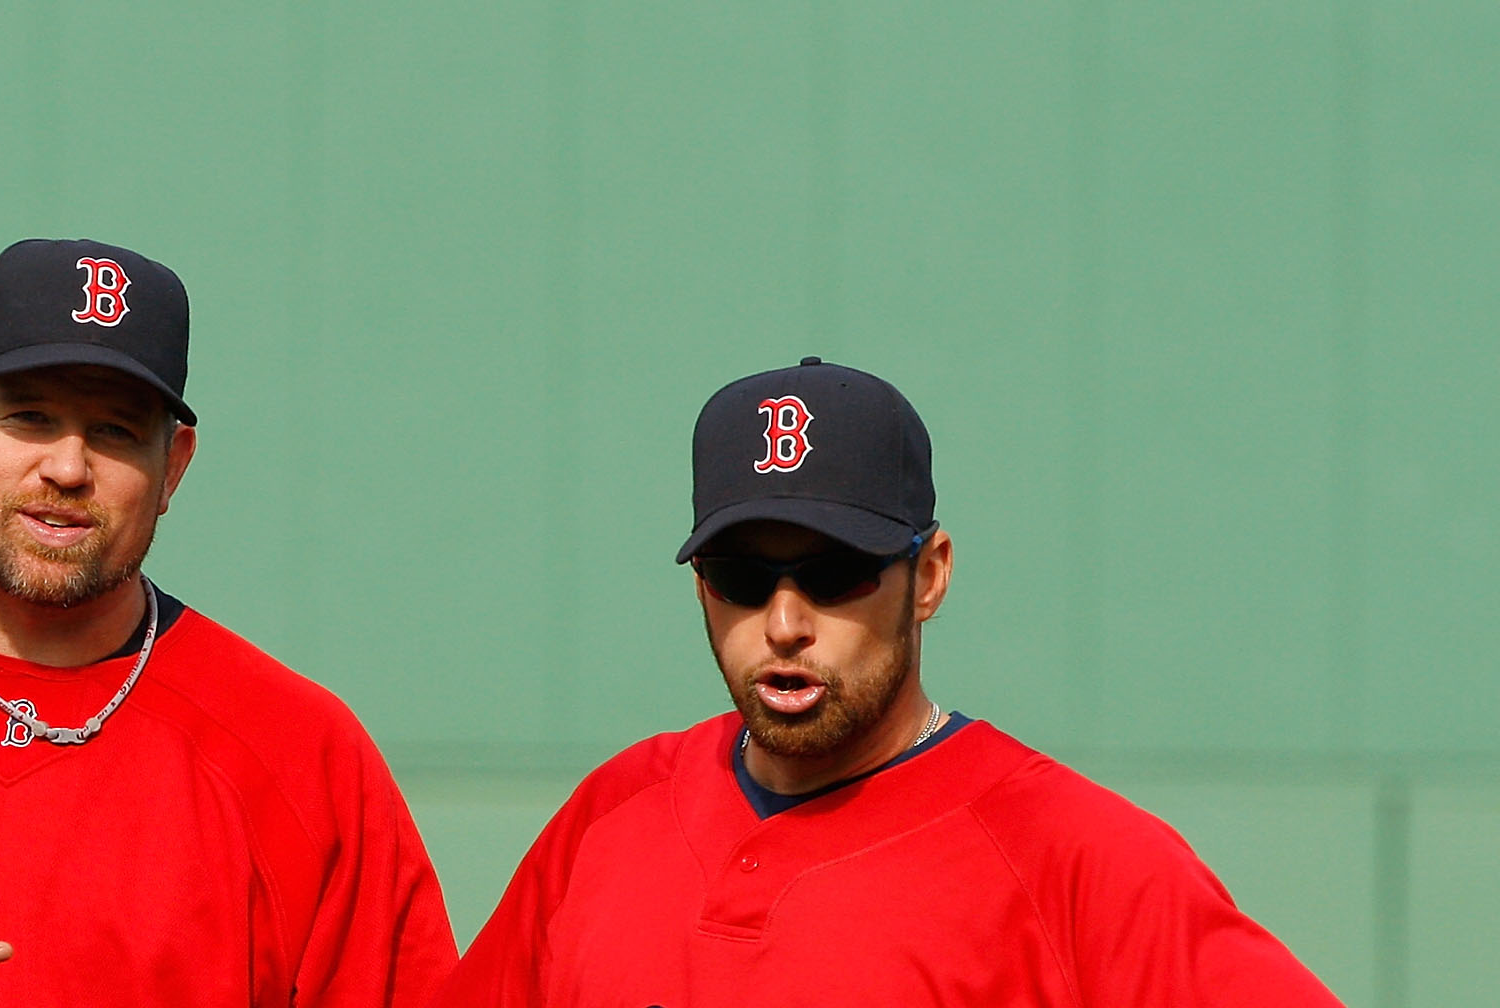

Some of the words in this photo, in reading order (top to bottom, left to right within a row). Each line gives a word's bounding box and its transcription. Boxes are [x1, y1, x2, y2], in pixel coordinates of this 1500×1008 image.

[71, 256, 132, 328] B
[753, 394, 815, 474] B
[0, 698, 38, 748] B
